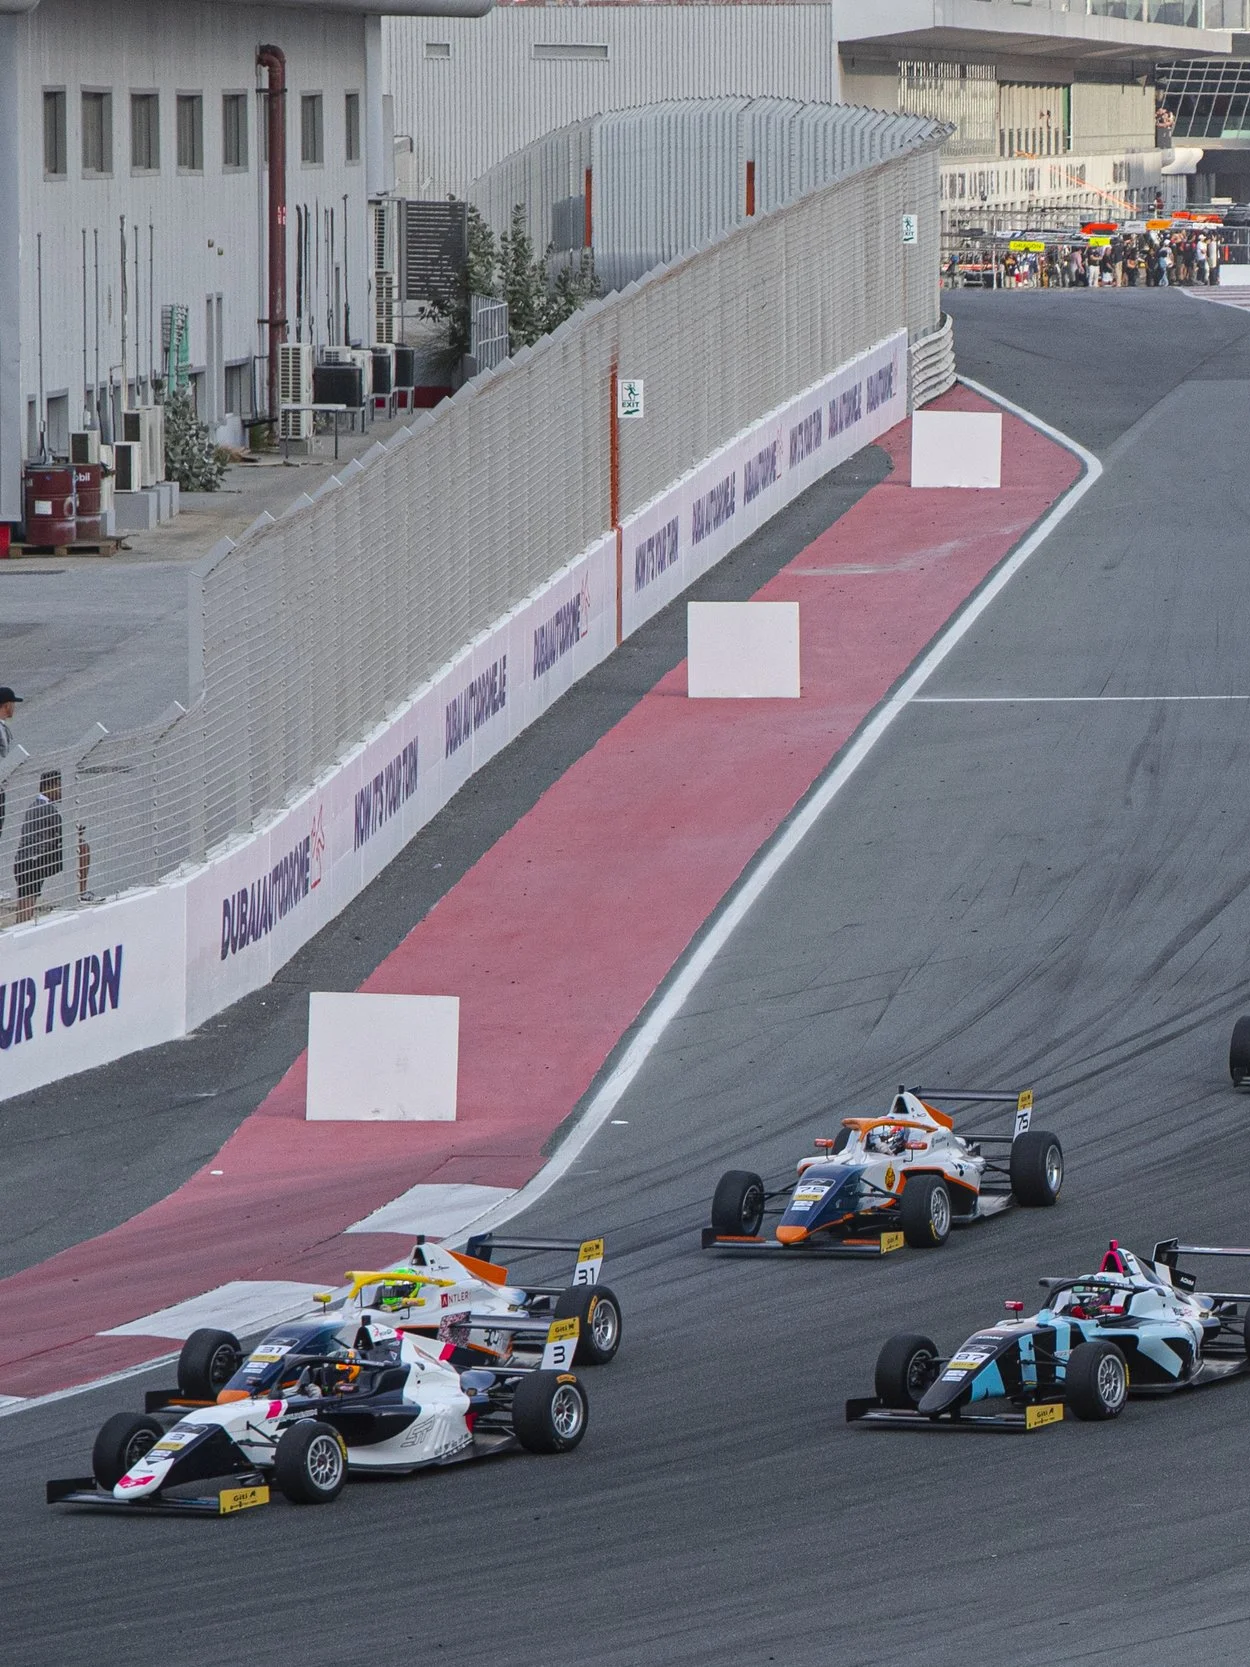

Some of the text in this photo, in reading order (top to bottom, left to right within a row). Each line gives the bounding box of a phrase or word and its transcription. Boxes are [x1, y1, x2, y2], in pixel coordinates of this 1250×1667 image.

[0, 944, 123, 1050] UR TURN
[1018, 1112, 1029, 1131] 75
[578, 1267, 595, 1285] 31
[553, 1345, 566, 1365] 3
